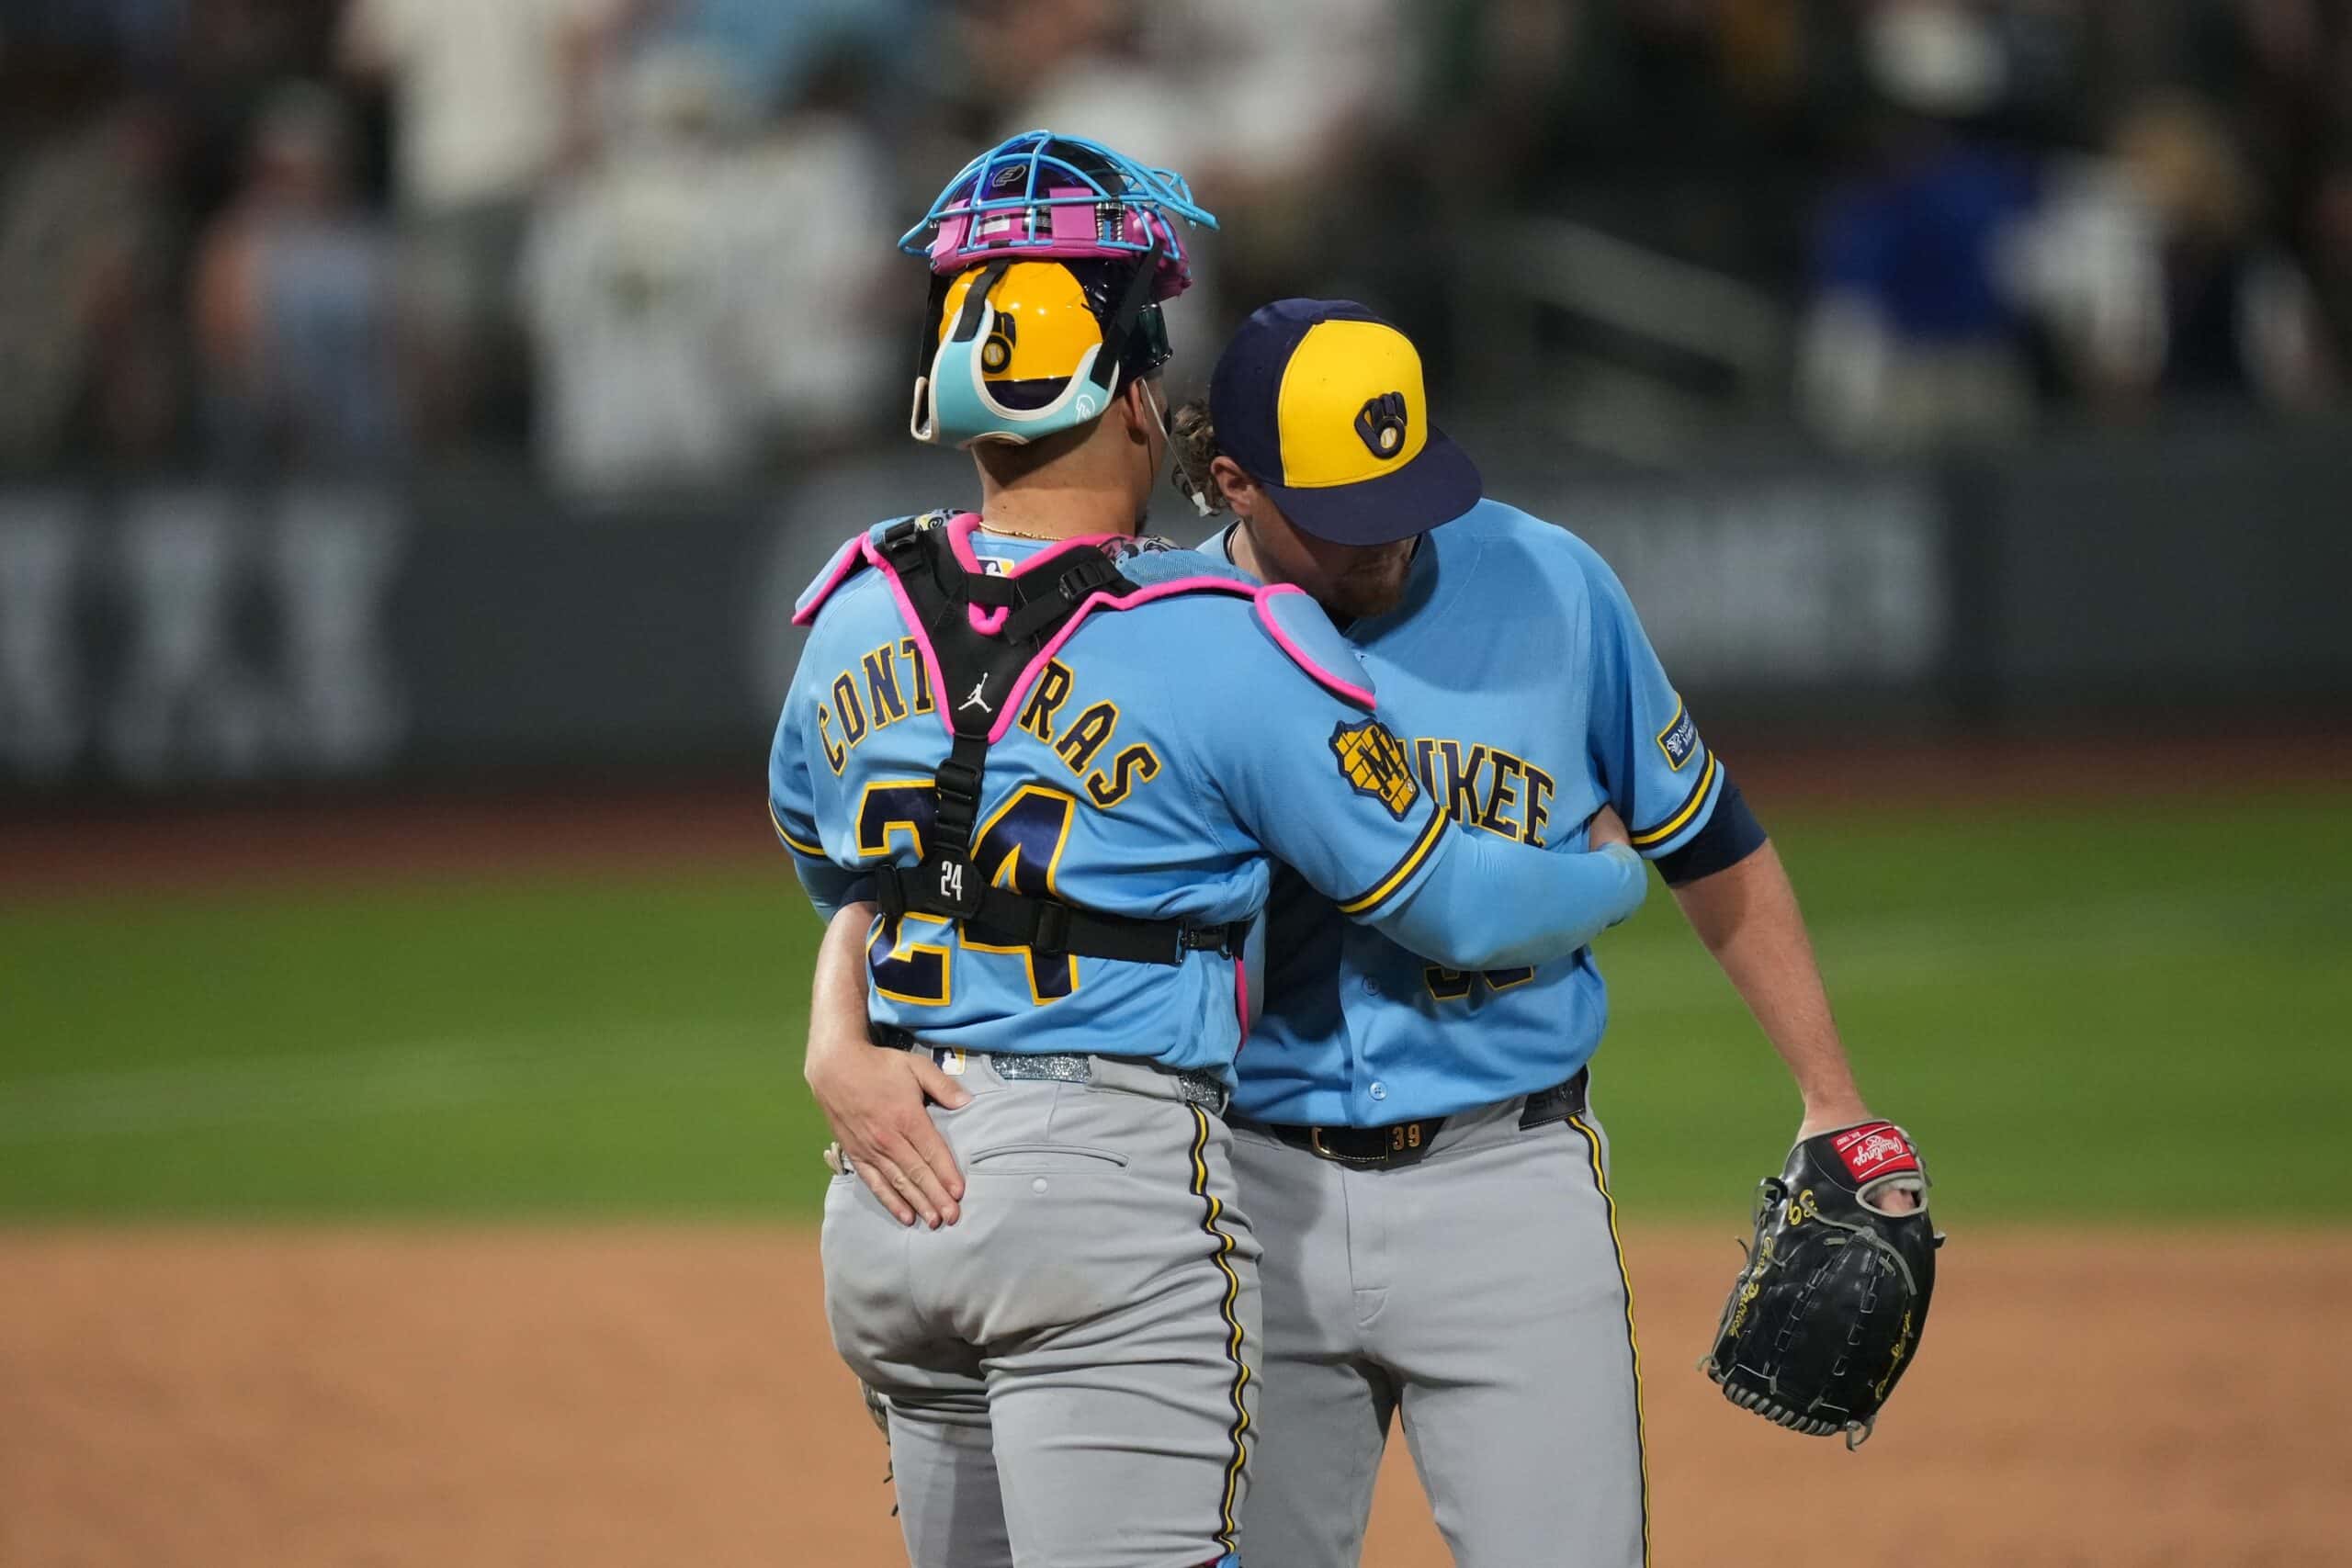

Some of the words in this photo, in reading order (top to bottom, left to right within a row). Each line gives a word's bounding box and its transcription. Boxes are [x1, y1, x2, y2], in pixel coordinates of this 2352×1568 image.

[817, 636, 1162, 809] CONTRAS
[855, 778, 1080, 1007] 24
[940, 860, 963, 902] 24
[1392, 1123, 1422, 1151] 39
